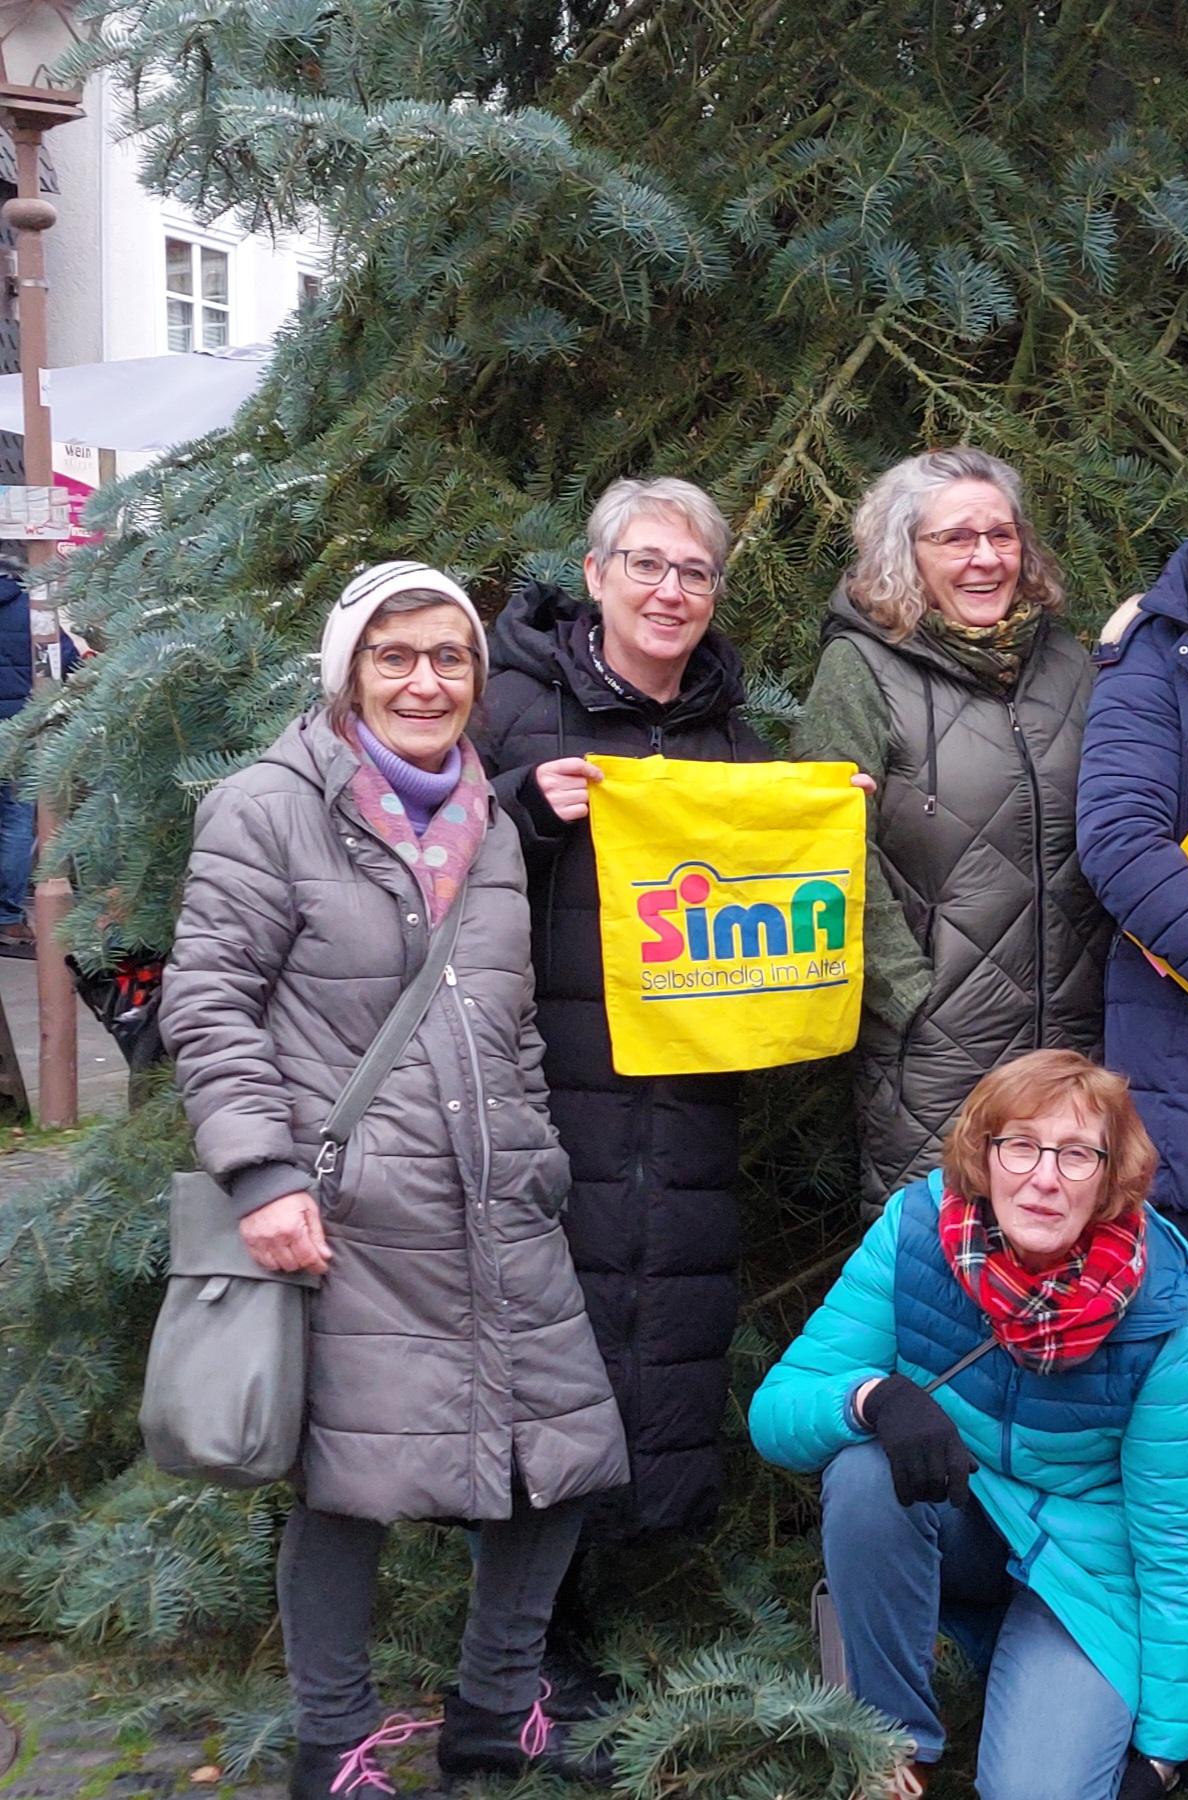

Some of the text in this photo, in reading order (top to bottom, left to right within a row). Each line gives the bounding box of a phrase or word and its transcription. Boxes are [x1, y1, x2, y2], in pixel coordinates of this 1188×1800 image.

[637, 874, 846, 963] SimA
[641, 959, 847, 989] Selbständig im Alter
